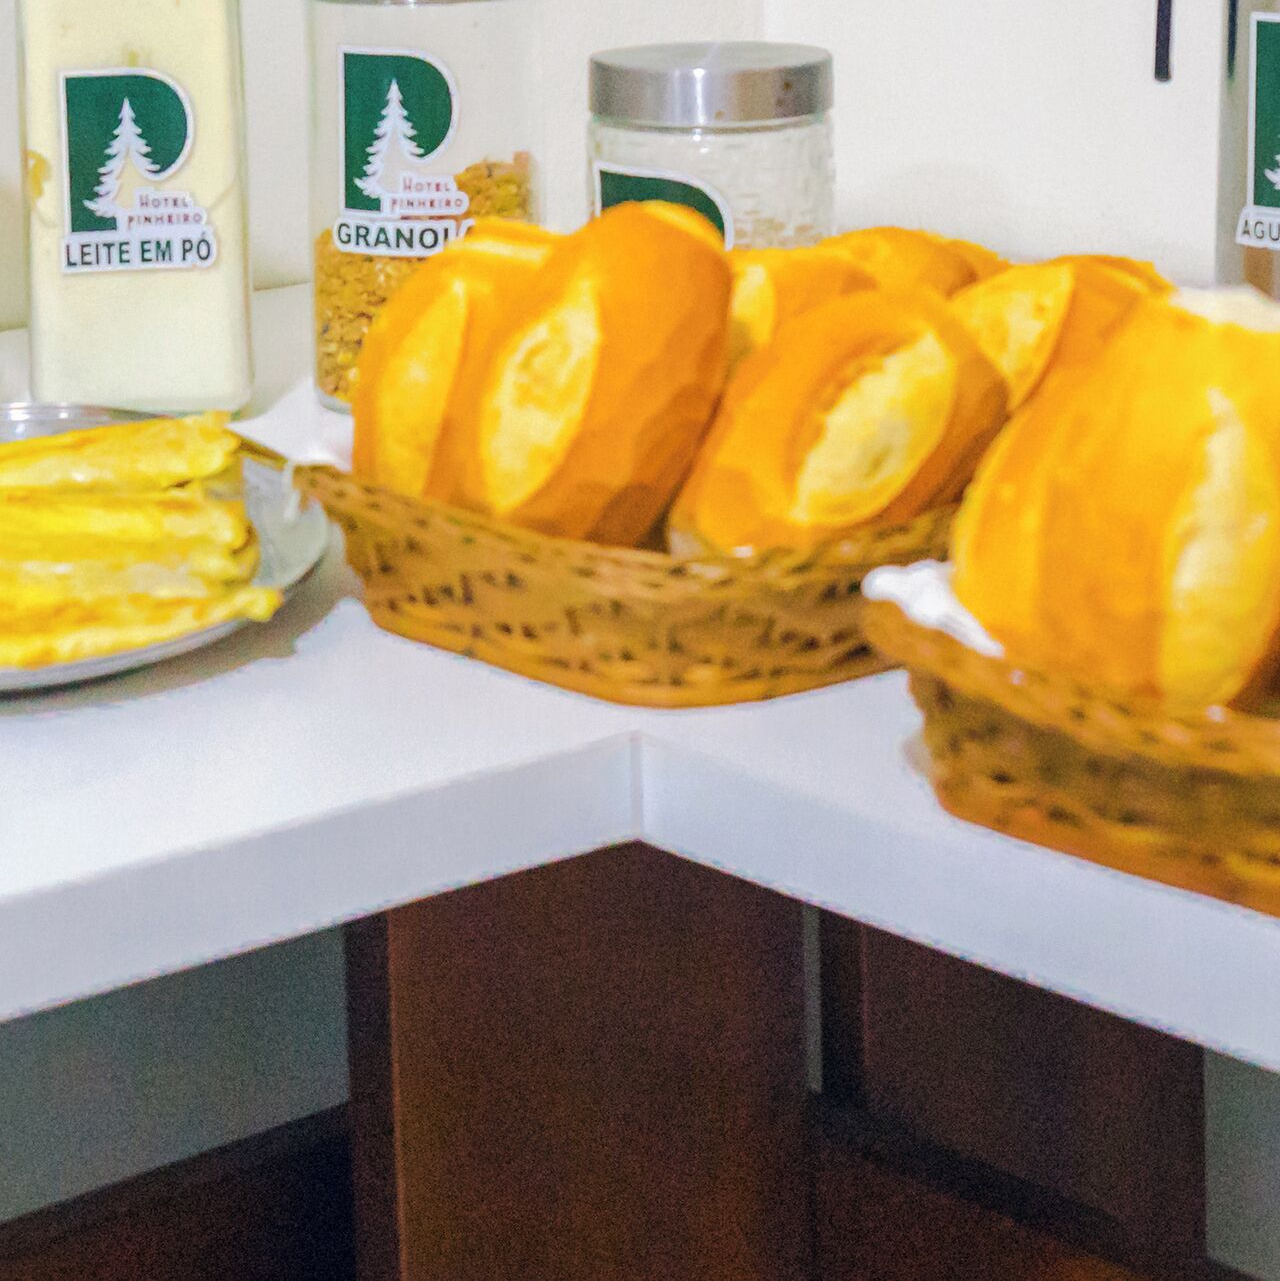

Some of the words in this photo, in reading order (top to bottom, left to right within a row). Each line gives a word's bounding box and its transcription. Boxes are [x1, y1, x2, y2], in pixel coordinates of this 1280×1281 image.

[65, 241, 131, 267] LEITE
[140, 239, 172, 263] EM
[181, 230, 211, 262] PÓ
[336, 222, 450, 249] GRANO
